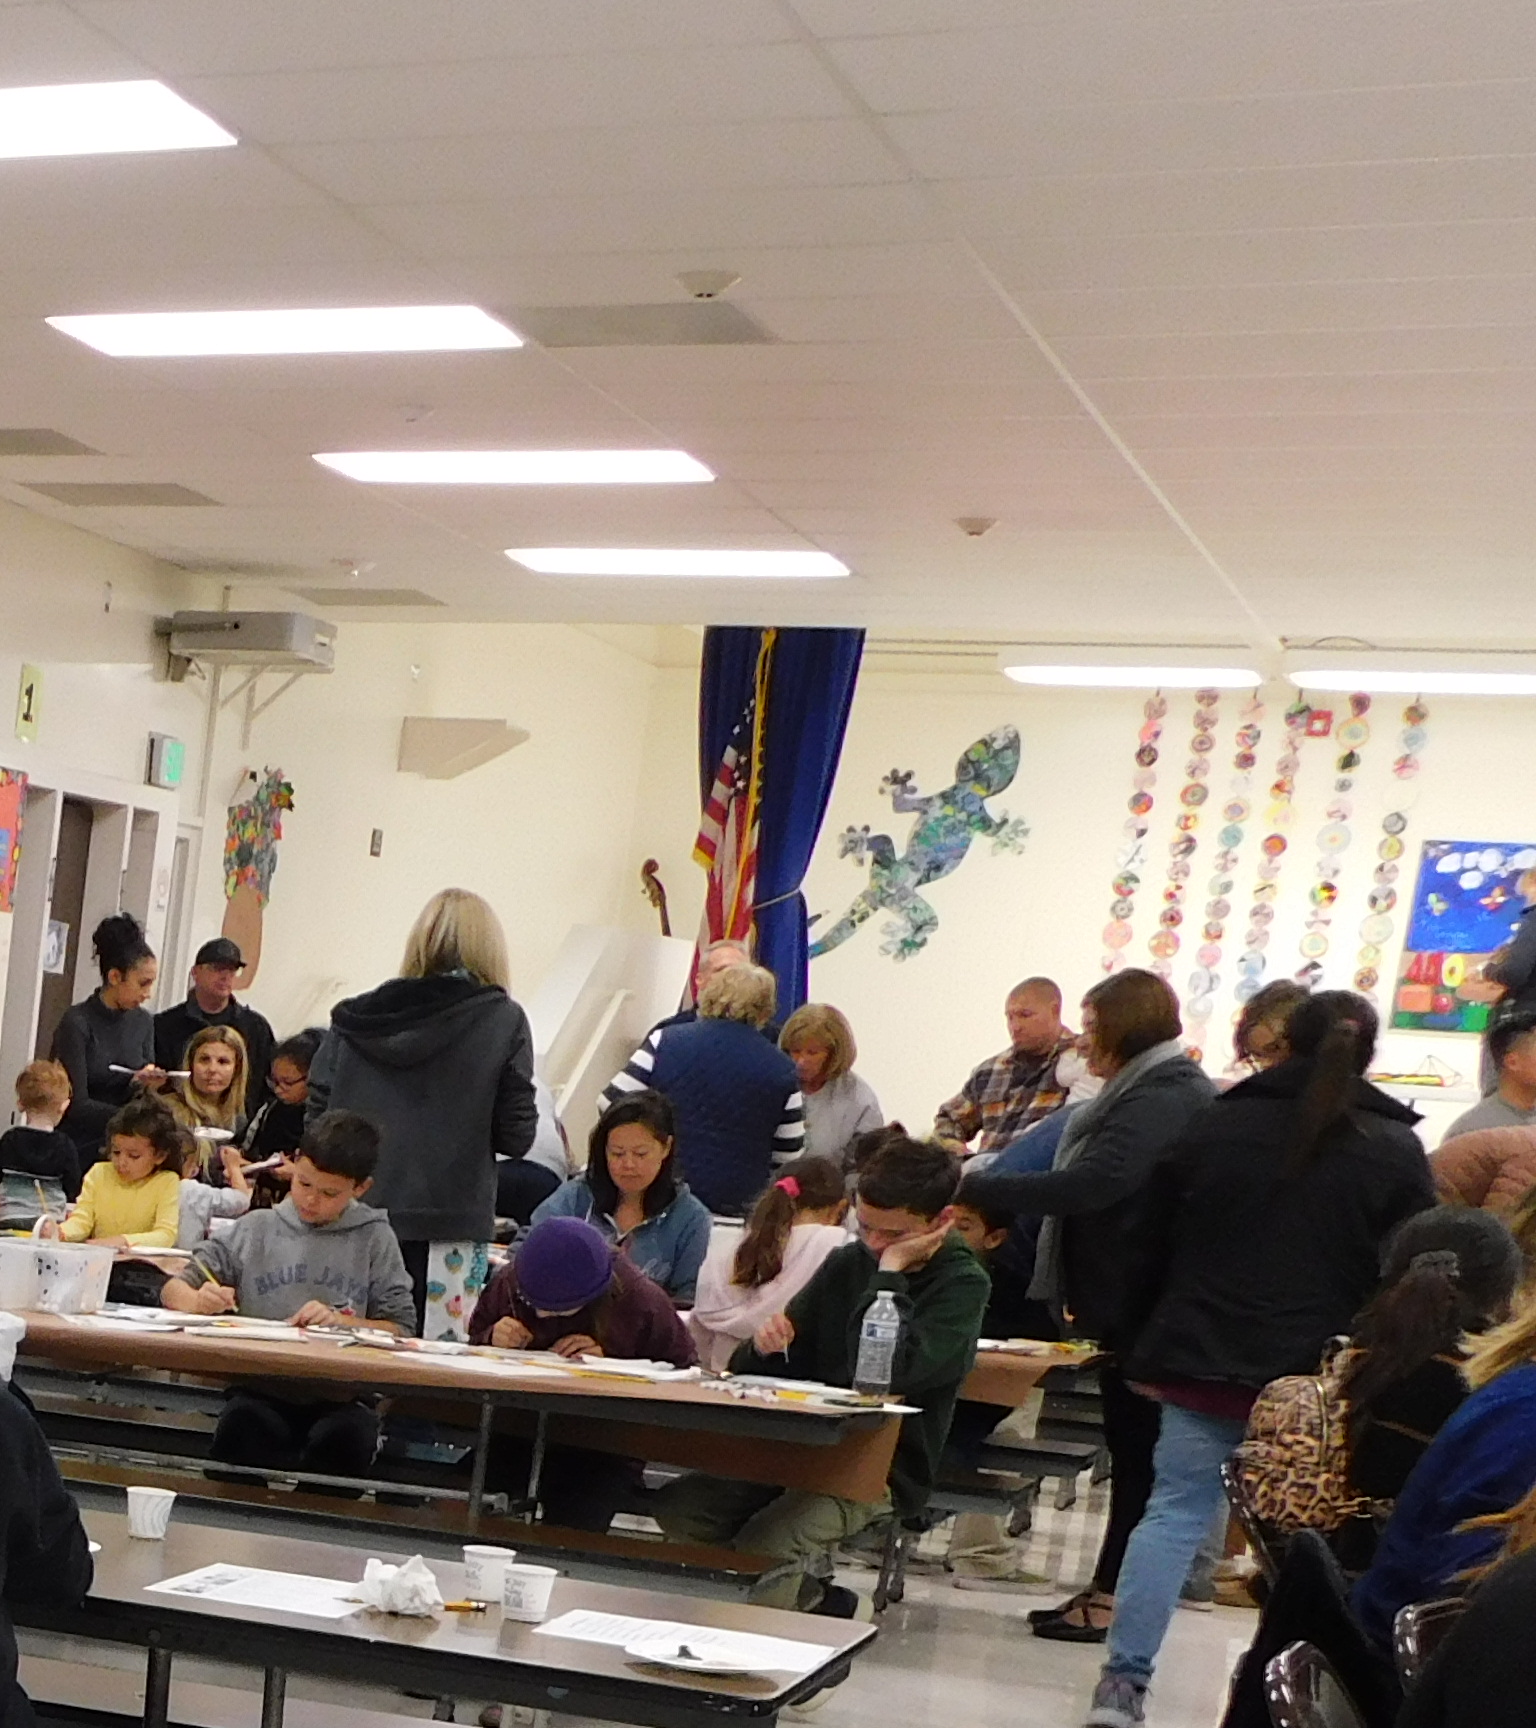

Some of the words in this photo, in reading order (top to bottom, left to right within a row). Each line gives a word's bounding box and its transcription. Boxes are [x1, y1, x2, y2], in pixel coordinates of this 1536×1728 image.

[23, 683, 34, 723] 1
[255, 1263, 308, 1296] BLUE
[313, 1264, 368, 1304] JAYS
